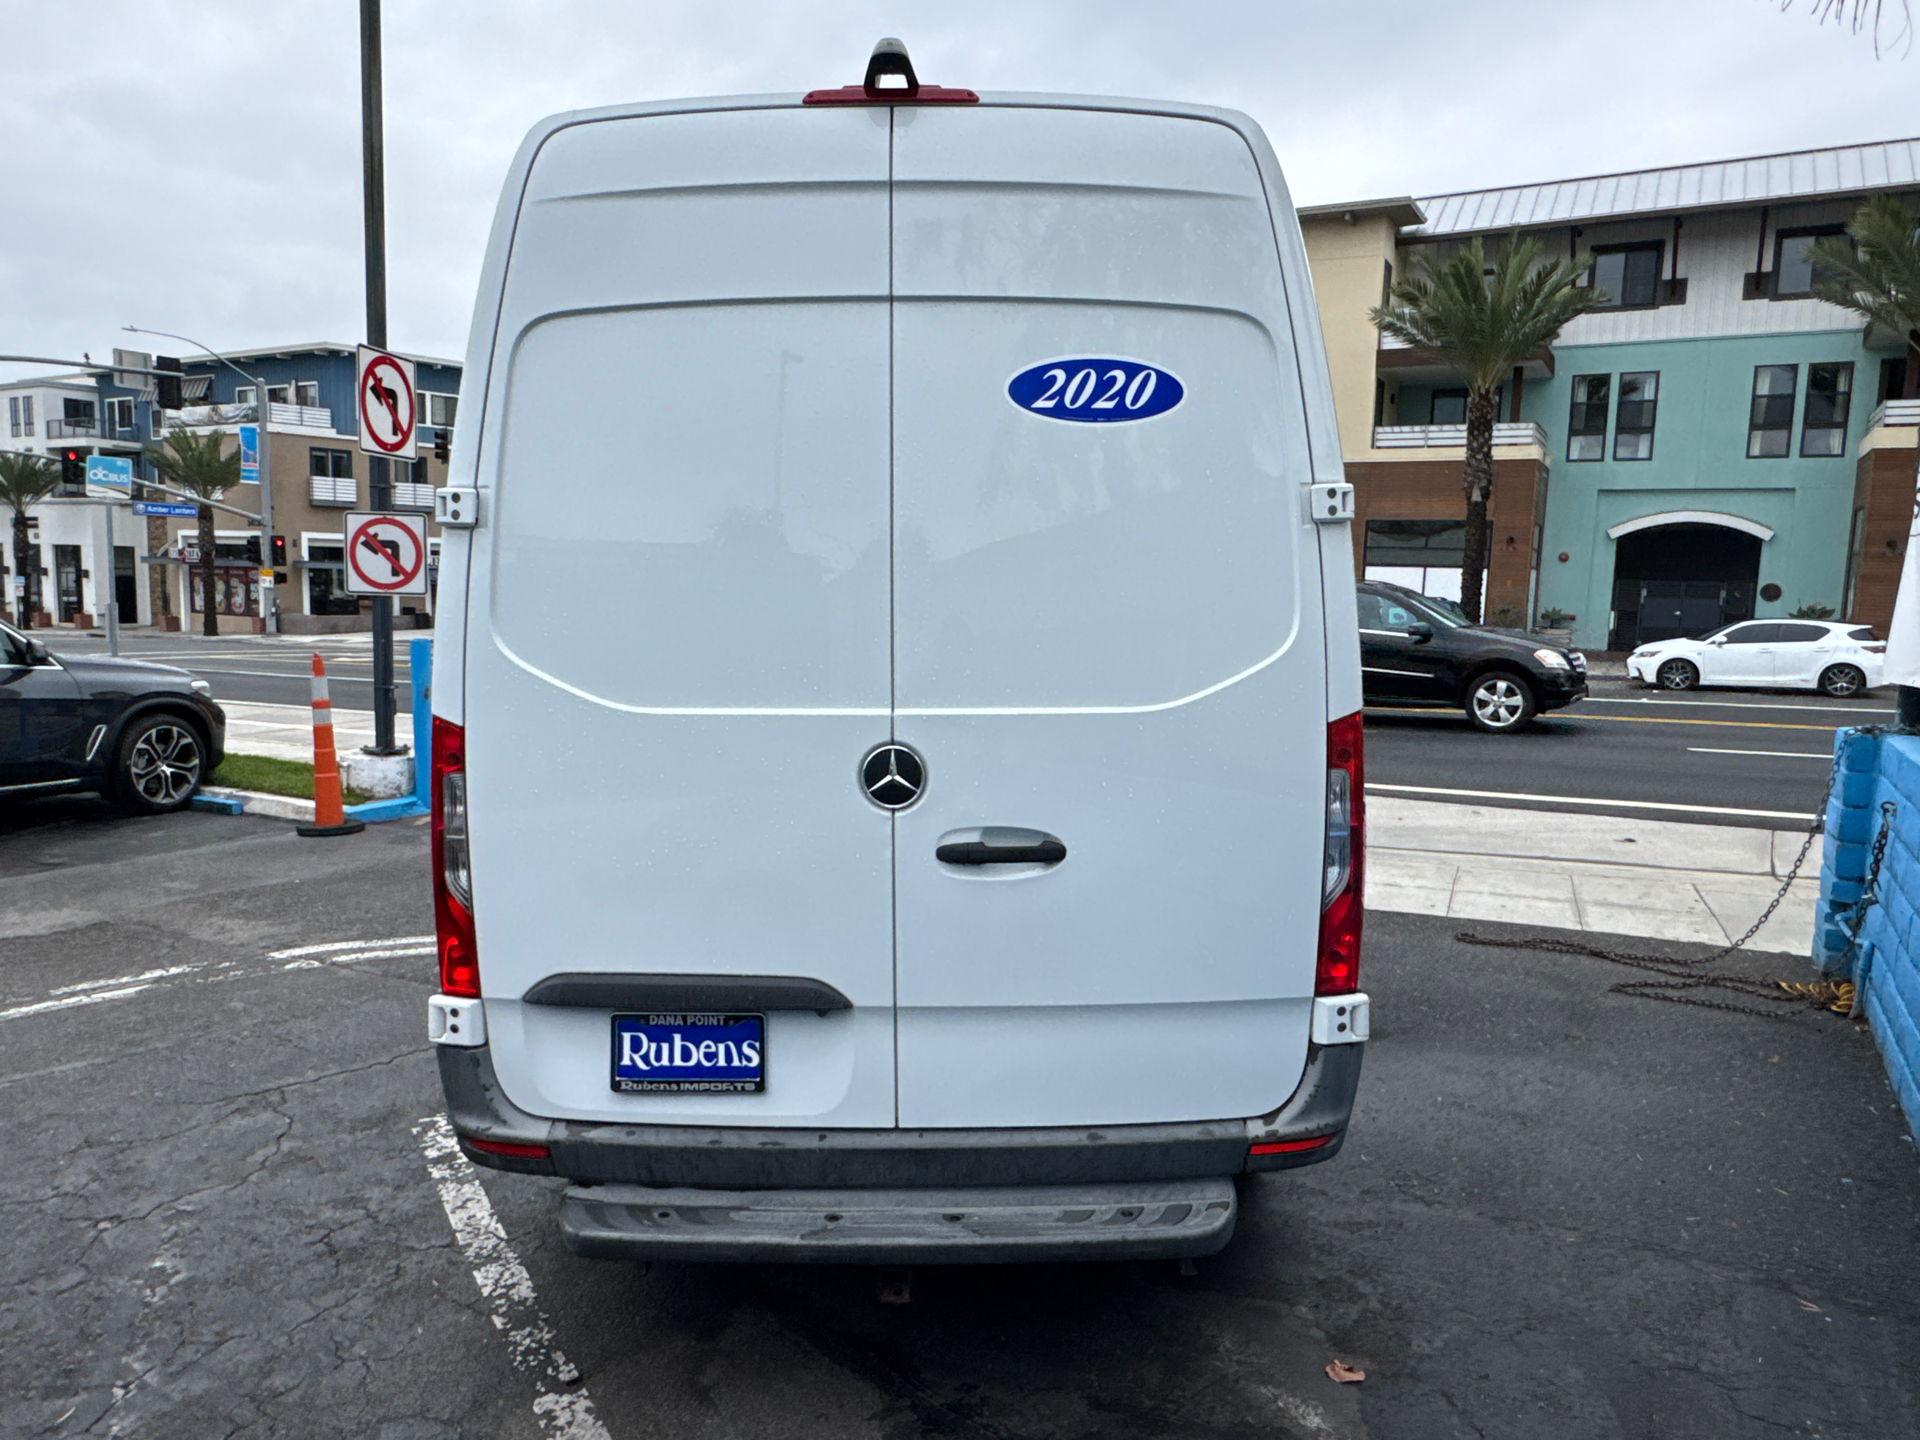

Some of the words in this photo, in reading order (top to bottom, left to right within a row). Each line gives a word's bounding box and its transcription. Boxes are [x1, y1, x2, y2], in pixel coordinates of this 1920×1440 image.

[1030, 368, 1157, 410] 2020
[147, 505, 169, 513] Amber
[649, 1015, 684, 1026] DANA
[686, 1015, 726, 1026] POINT
[619, 1032, 760, 1071] Rubens
[620, 1081, 679, 1091] Rubens
[680, 1082, 756, 1091] IMPORTS
